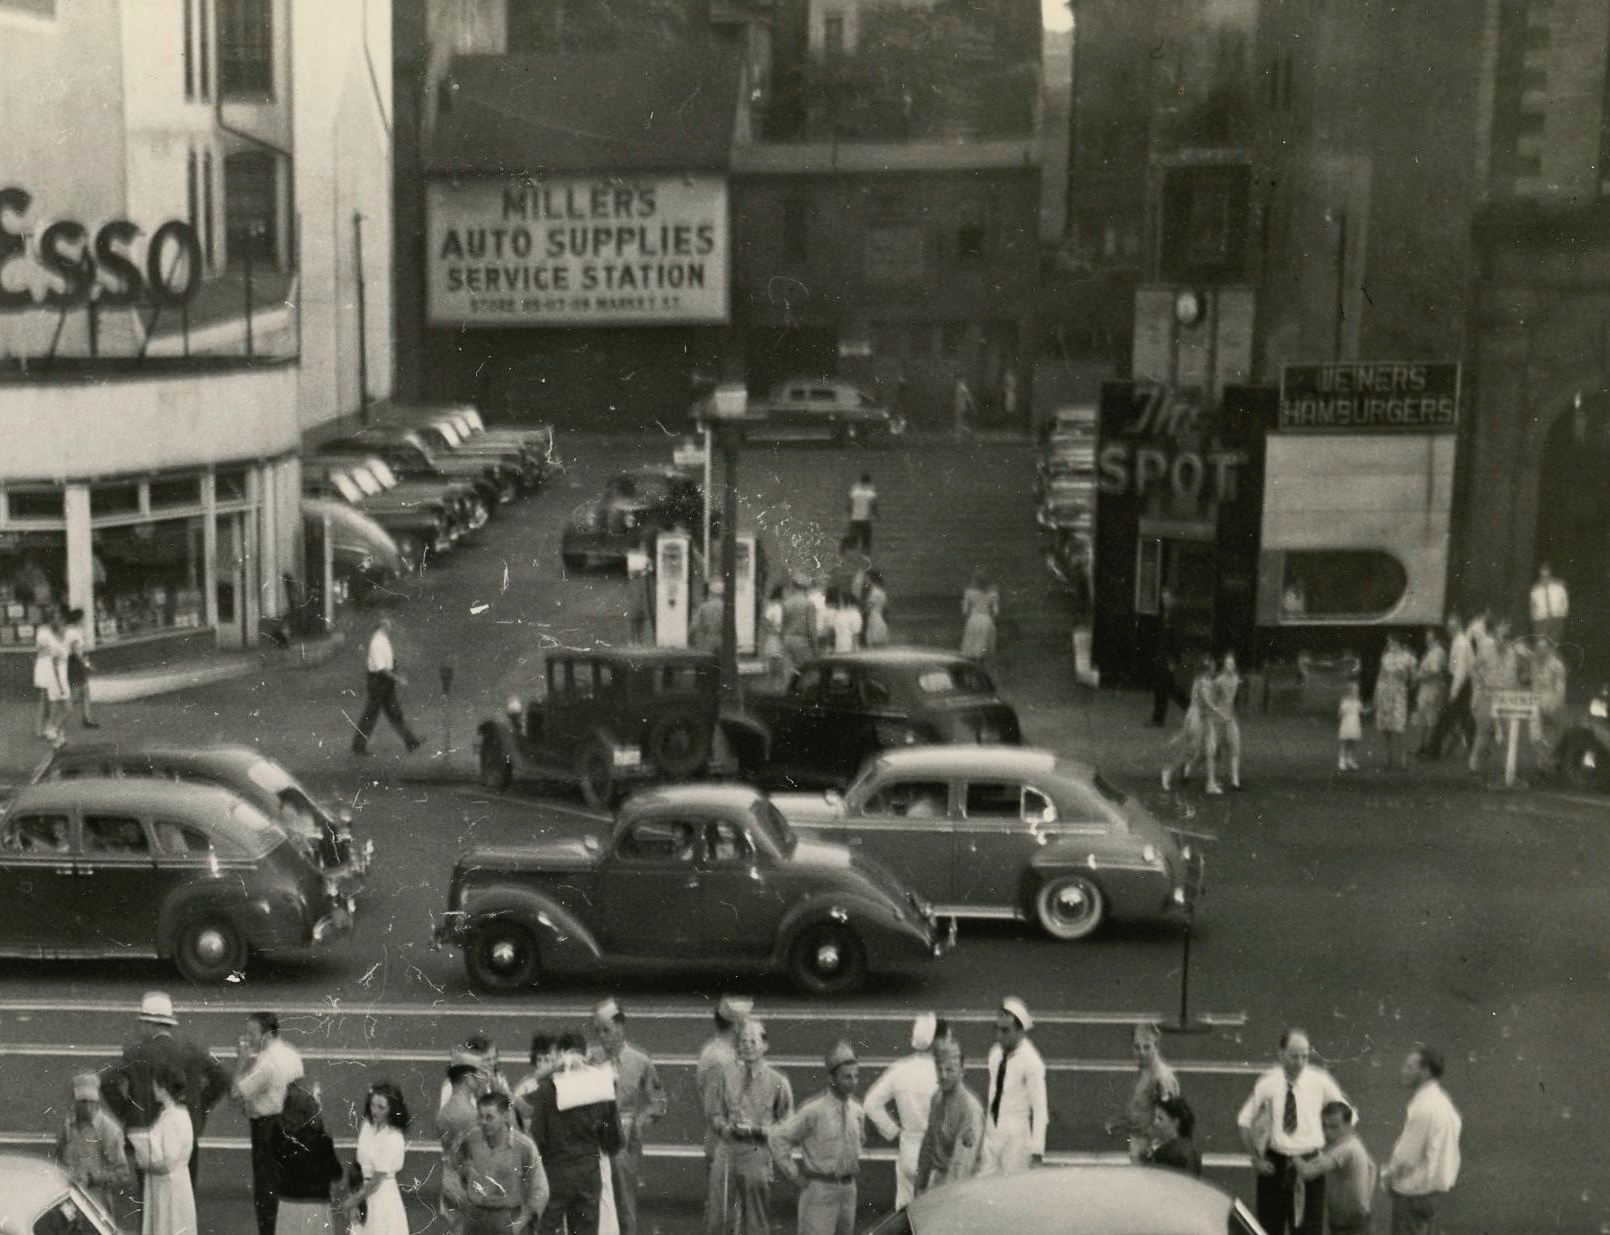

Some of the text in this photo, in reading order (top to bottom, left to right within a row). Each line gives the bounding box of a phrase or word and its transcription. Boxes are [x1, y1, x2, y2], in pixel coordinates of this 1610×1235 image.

[440, 225, 715, 260] AUTO SUPPLIES
[446, 263, 706, 293] SERVICE STATION
[1317, 365, 1427, 392] WEINERS
[1284, 398, 1454, 425] HAMBURGERS
[1097, 445, 1242, 501] SPOT
